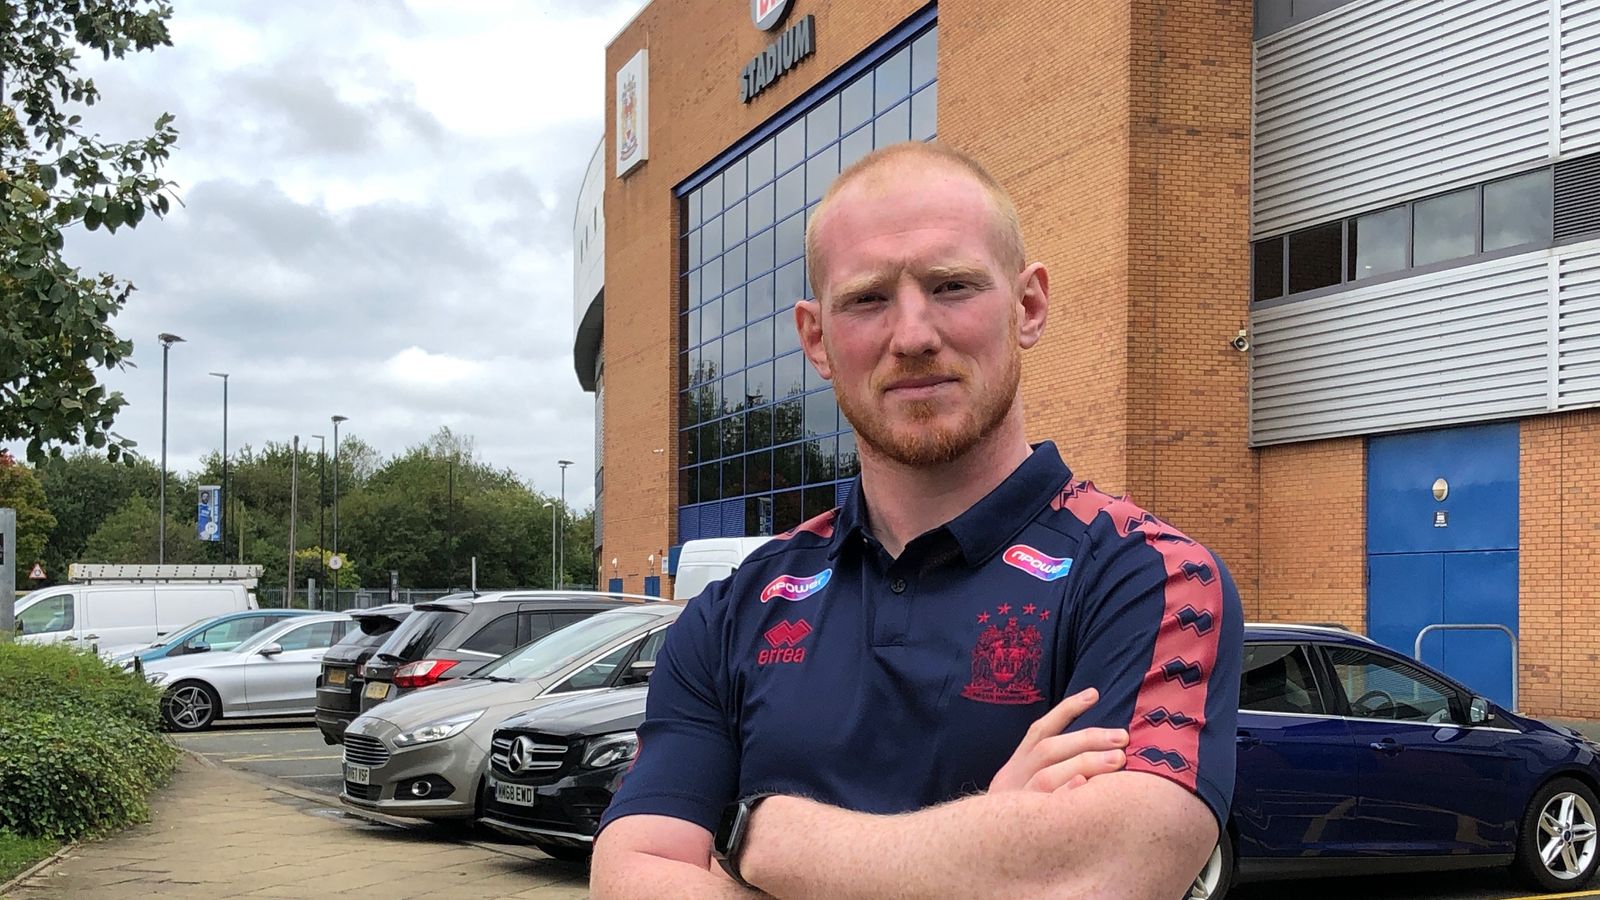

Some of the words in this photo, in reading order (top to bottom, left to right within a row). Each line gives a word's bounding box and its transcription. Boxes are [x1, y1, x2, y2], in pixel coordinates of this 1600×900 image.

[739, 14, 812, 104] STADIUM
[1011, 550, 1069, 574] npower
[766, 575, 826, 596] npower
[757, 646, 806, 665] errea
